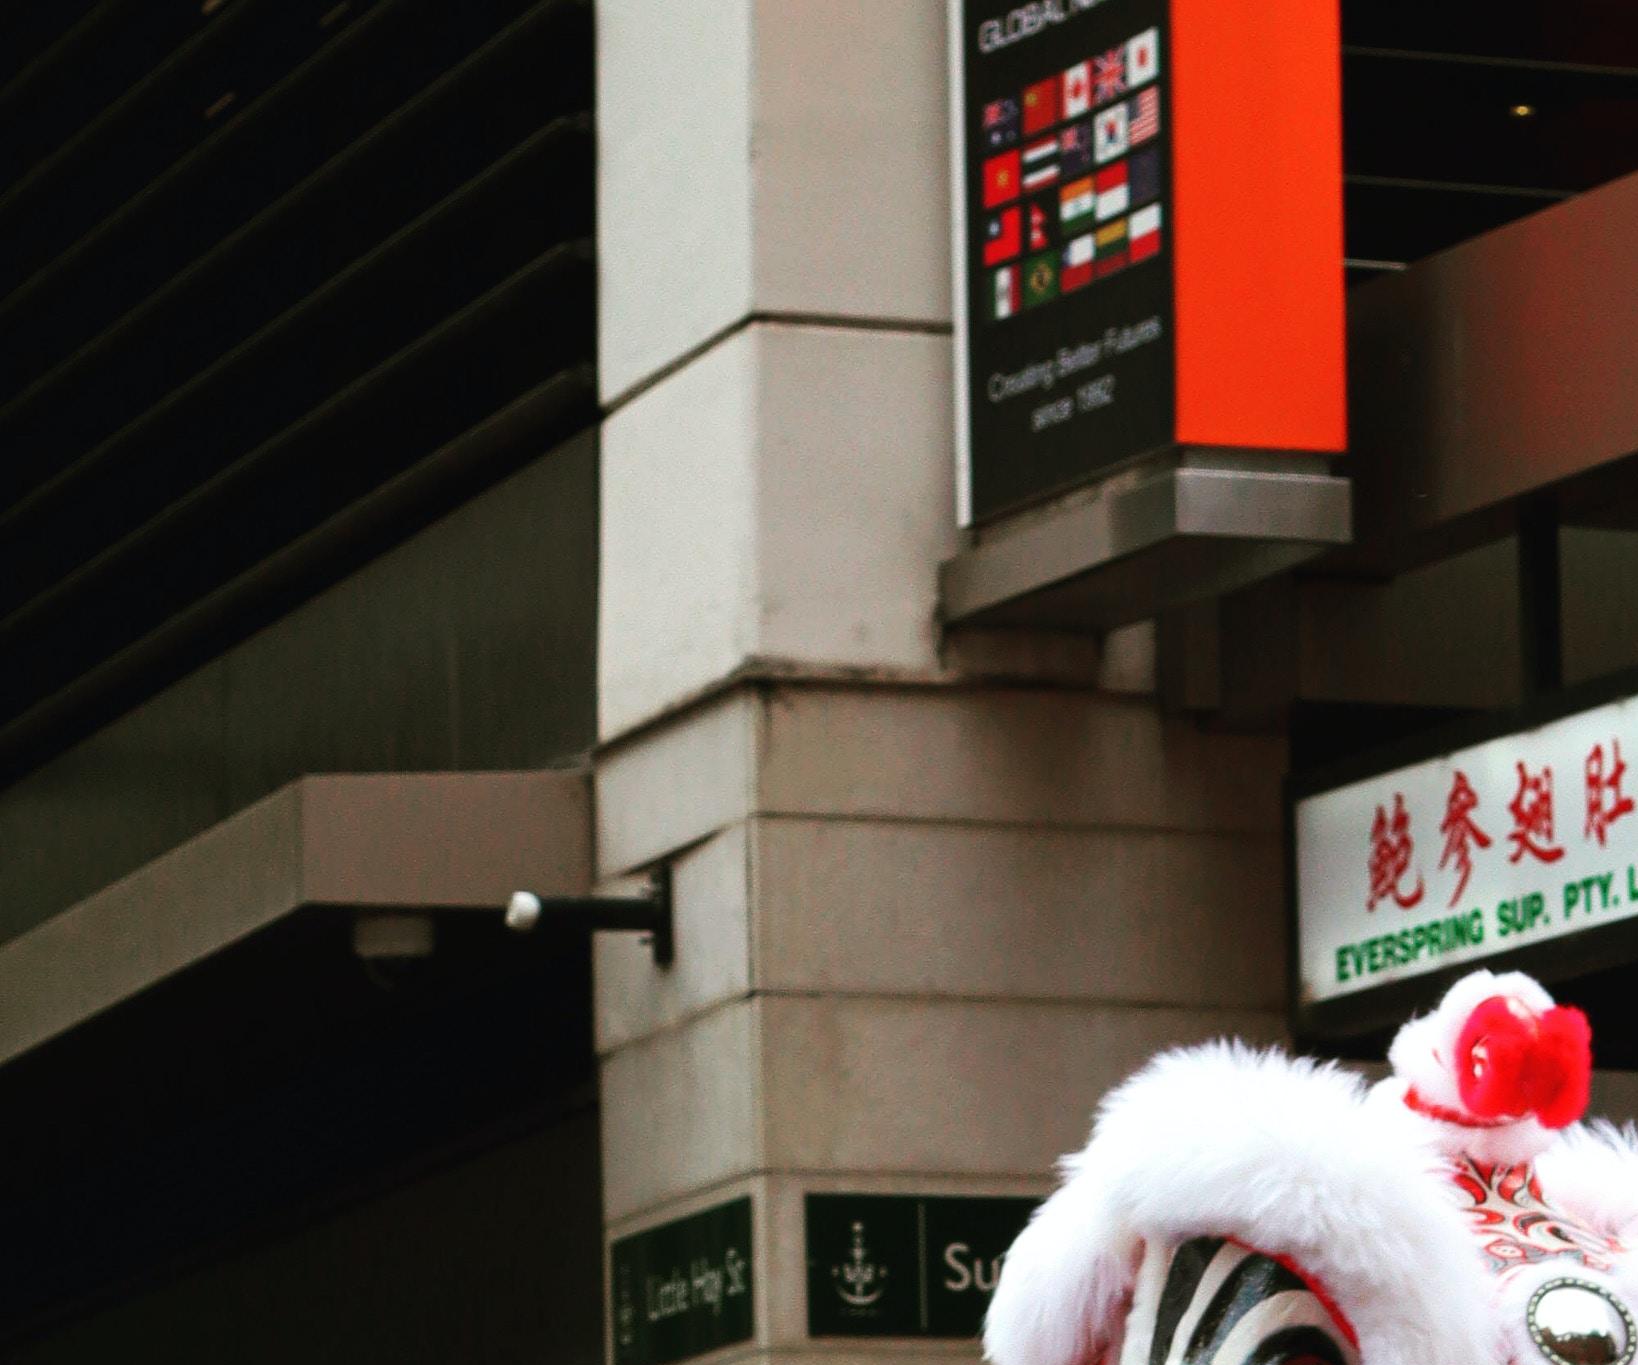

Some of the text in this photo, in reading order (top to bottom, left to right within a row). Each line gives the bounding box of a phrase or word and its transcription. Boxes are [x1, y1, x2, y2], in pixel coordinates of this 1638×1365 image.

[988, 360, 1055, 403] Creating
[1056, 342, 1101, 378] Better
[1336, 909, 1485, 982] EVERSPRING
[1496, 893, 1550, 938] SUP.
[1562, 873, 1619, 920] PTY.
[944, 1241, 1006, 1293] Su
